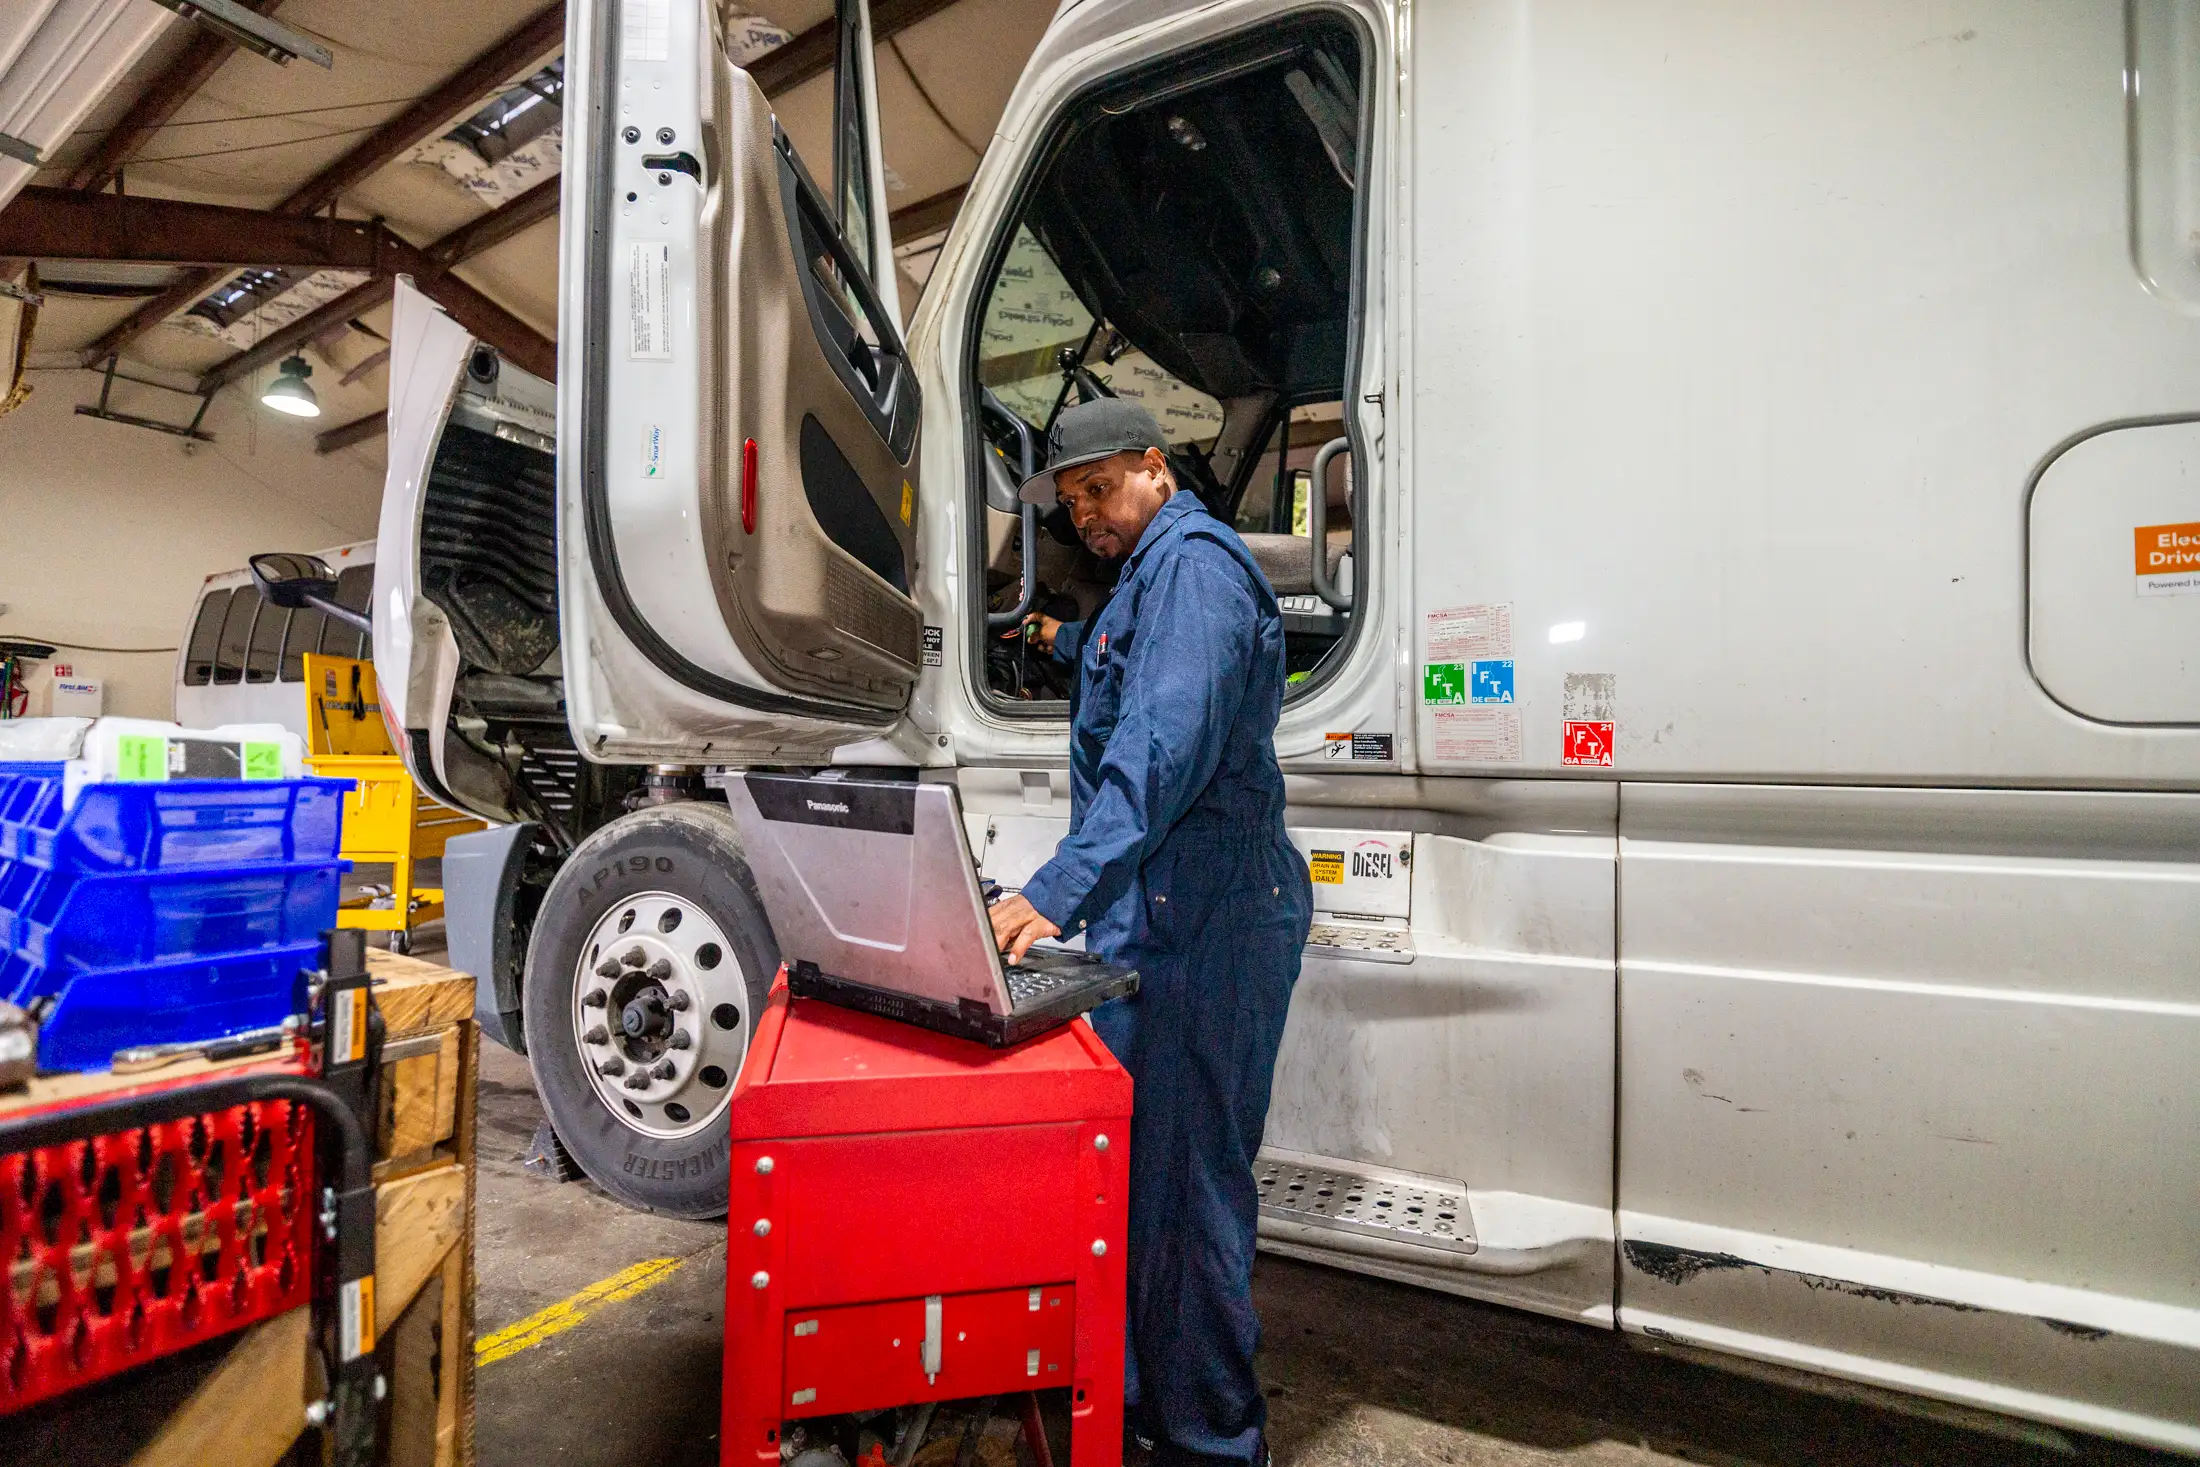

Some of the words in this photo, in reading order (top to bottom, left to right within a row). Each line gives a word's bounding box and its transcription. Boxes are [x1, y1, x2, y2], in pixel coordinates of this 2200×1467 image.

[2148, 580, 2190, 589] Powered
[923, 628, 941, 637] UCK
[1453, 663, 1464, 671] 23
[1502, 660, 1513, 668] 22
[806, 799, 850, 813] Panasonic
[1312, 852, 1342, 860] WARNING
[1352, 851, 1393, 879] DIESEL
[577, 855, 675, 905] AP190
[1315, 875, 1336, 883] DAILY
[623, 1138, 726, 1180] ANCASTER
